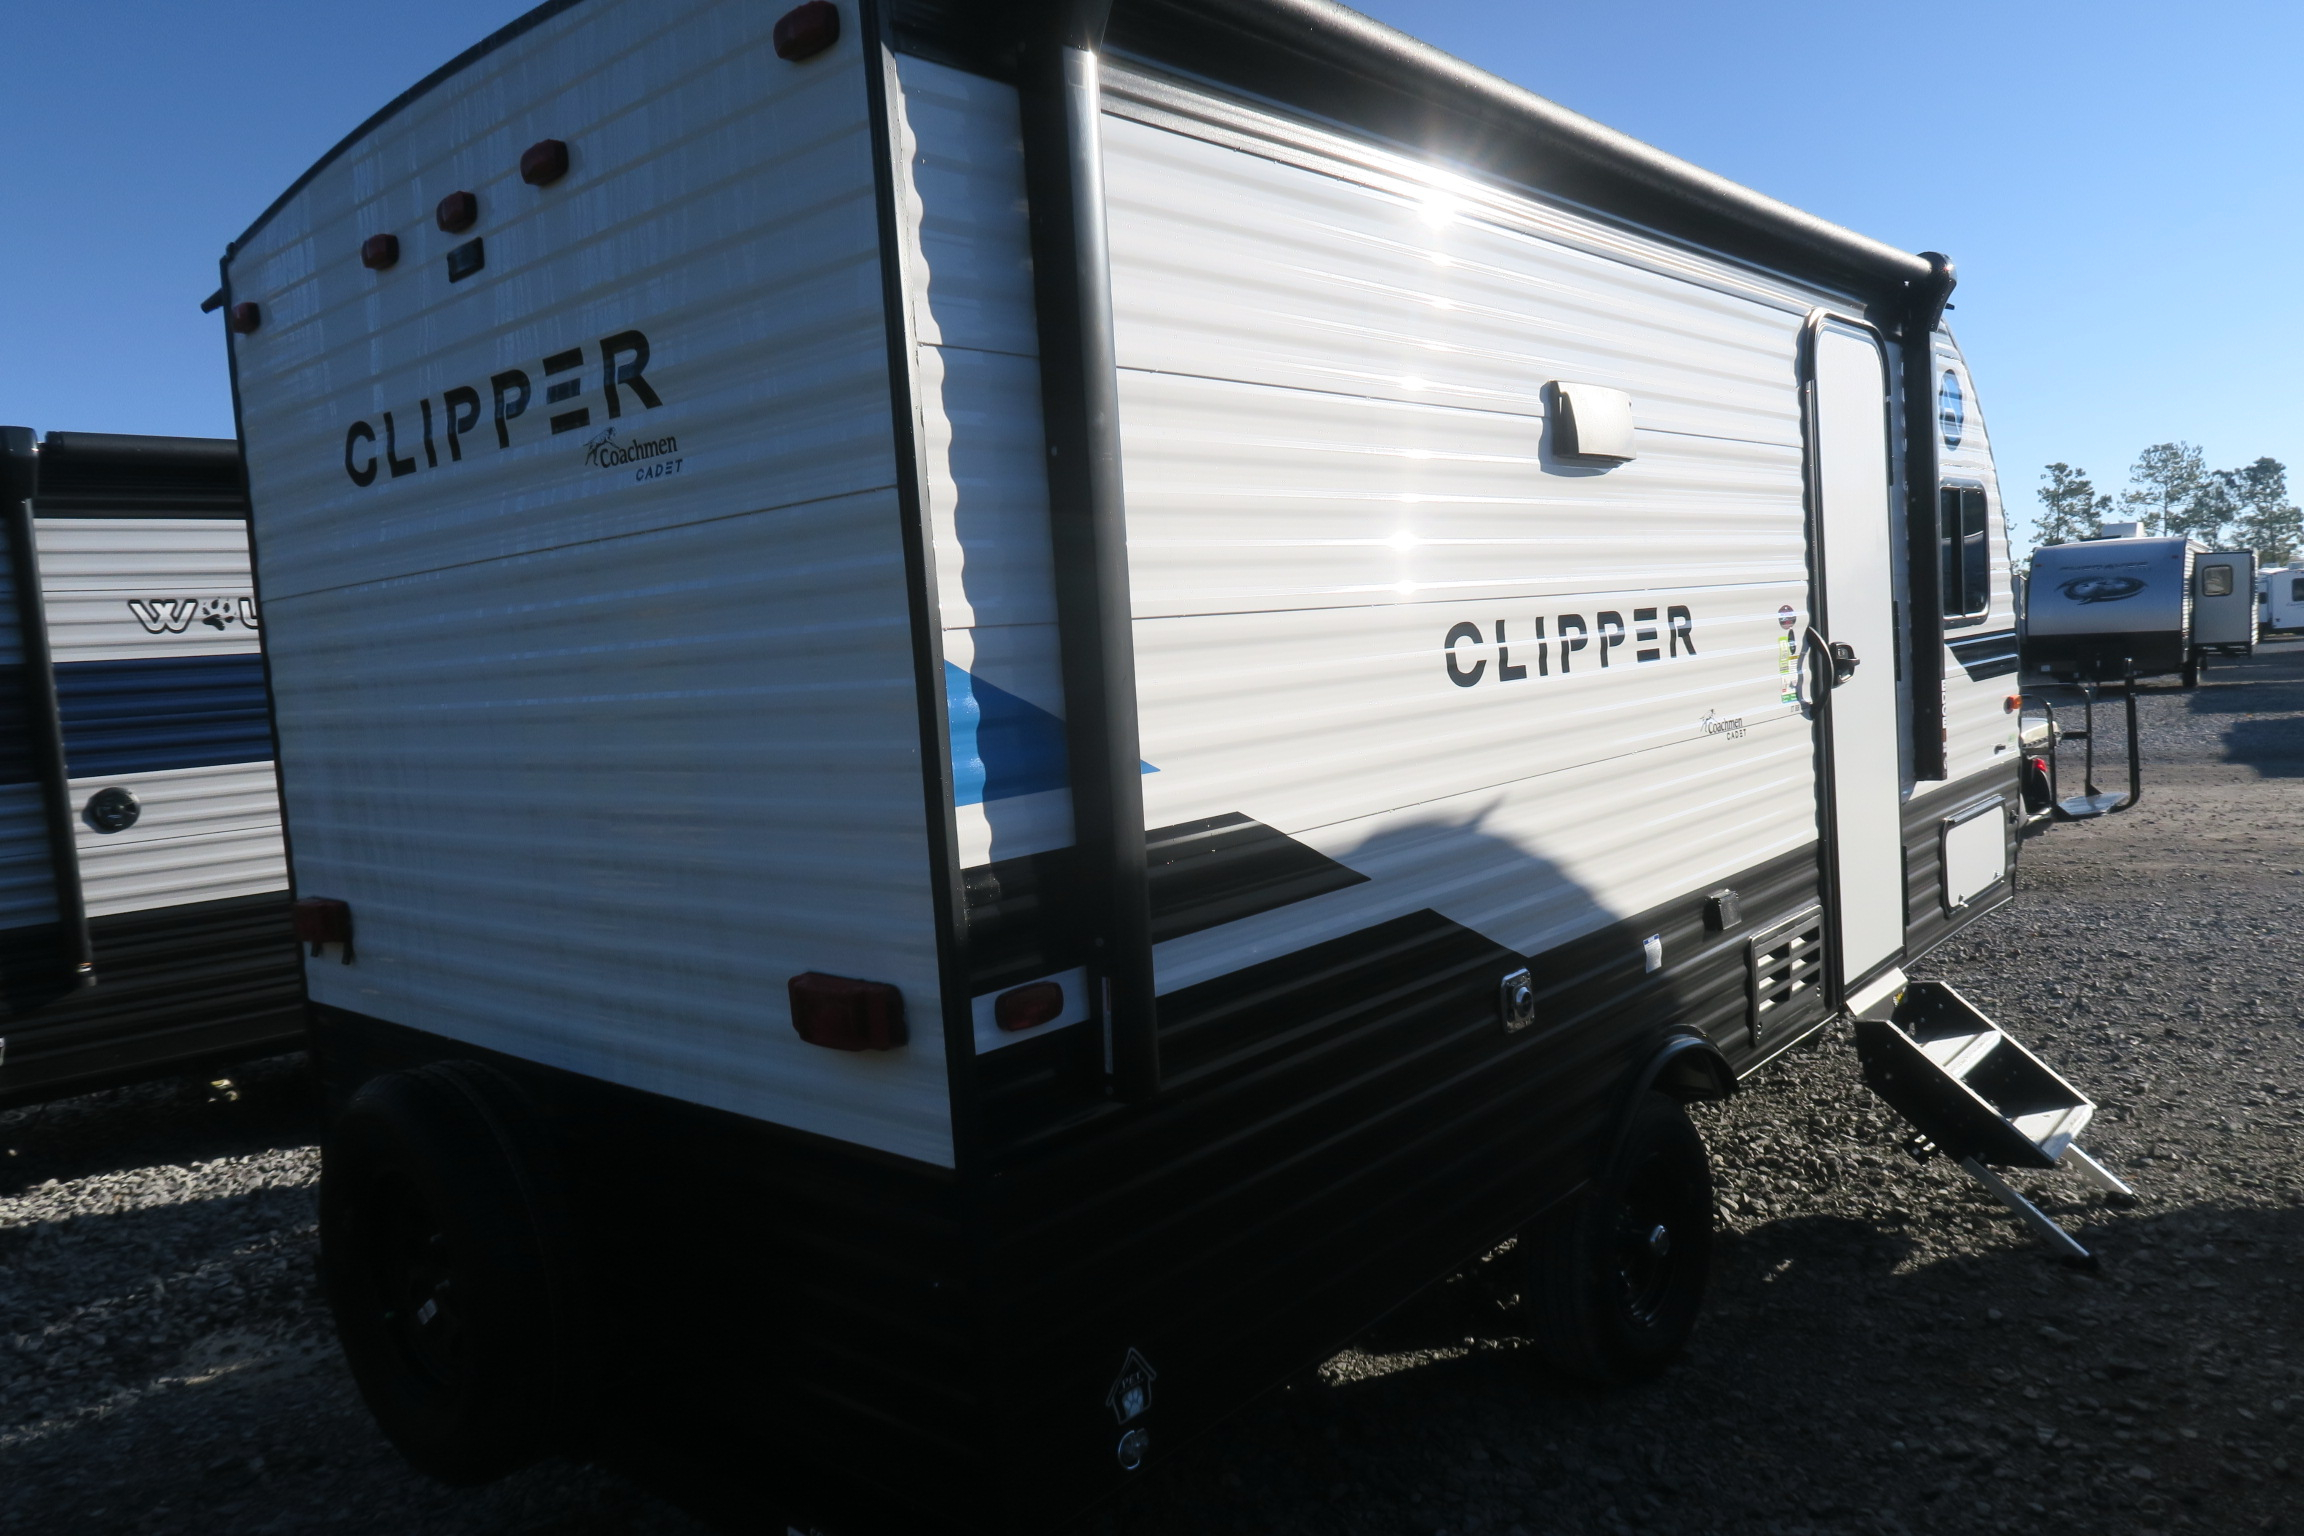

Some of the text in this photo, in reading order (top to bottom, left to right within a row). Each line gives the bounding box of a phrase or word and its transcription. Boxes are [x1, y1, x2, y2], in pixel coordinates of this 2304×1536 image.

[345, 330, 664, 488] CLIPPER
[600, 435, 678, 469] Coachmen
[635, 459, 684, 482] CADET
[1443, 604, 1697, 688] CLIPPER
[1707, 718, 1743, 734] Coachmen
[1726, 729, 1747, 741] CADET
